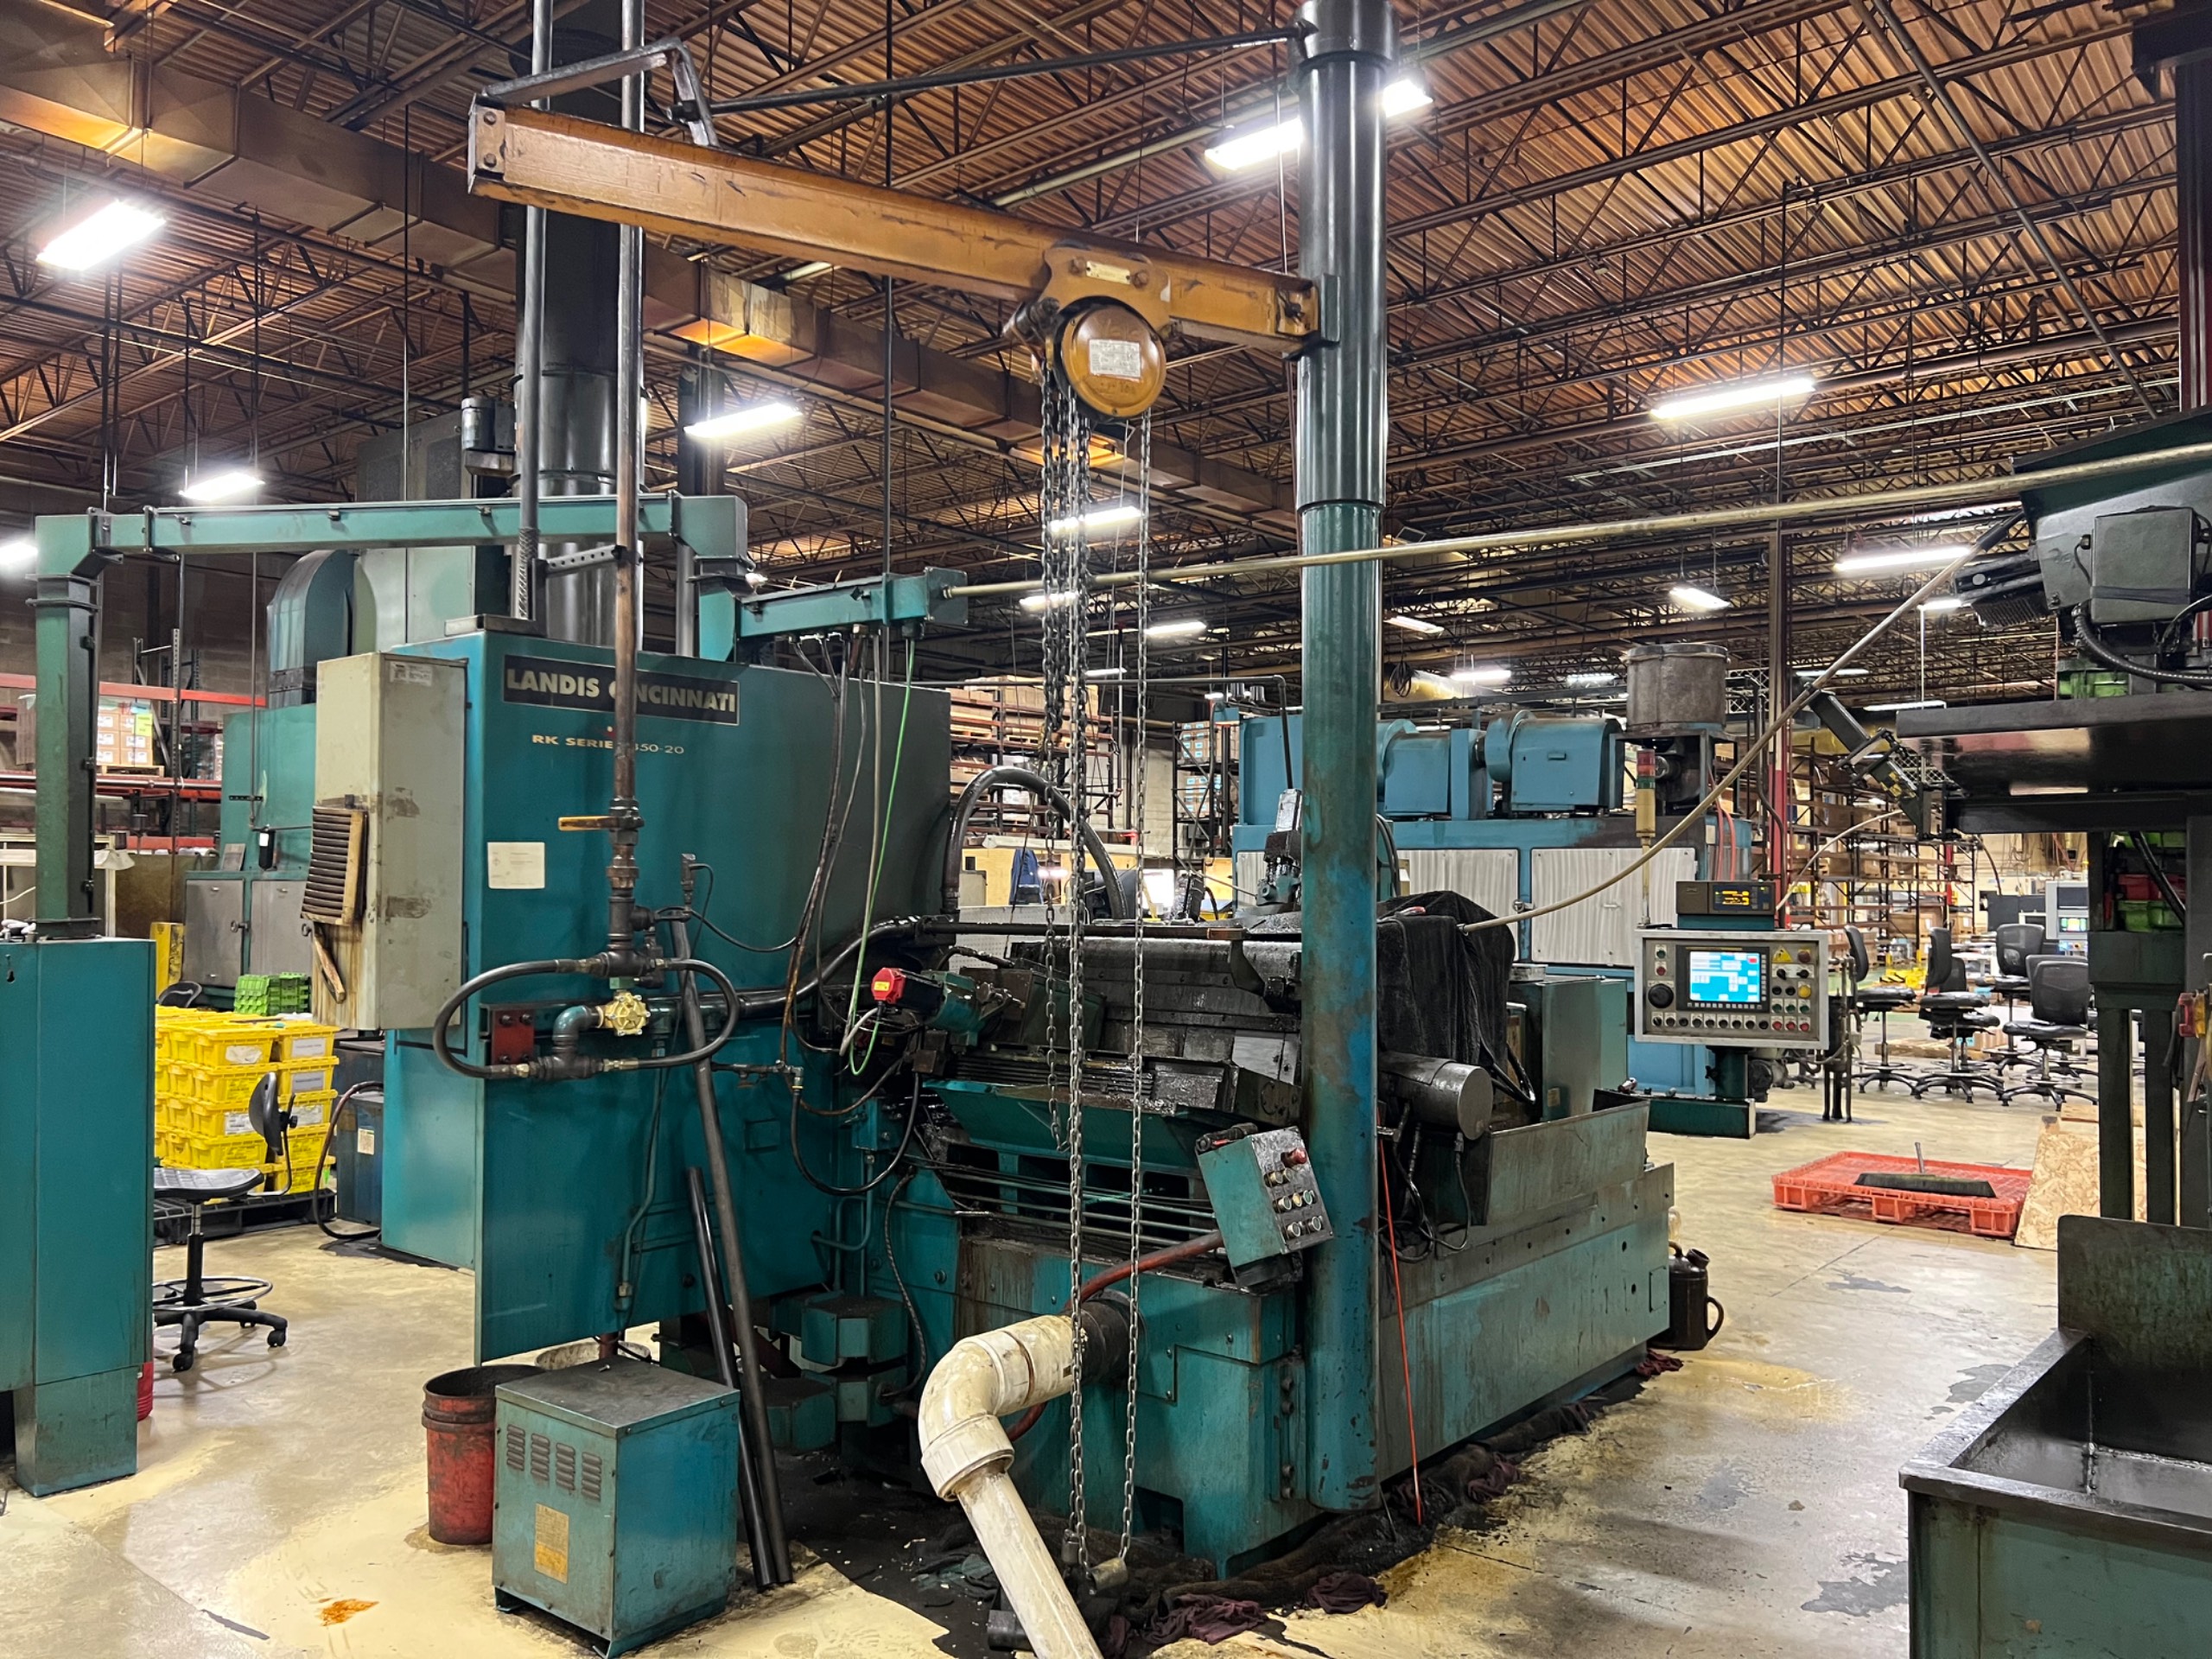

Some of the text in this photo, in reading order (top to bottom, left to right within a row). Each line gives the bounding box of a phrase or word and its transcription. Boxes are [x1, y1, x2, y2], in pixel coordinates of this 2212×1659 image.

[506, 668, 736, 713] LANDIS CNCINNATI
[531, 734, 559, 746] RK
[564, 737, 614, 749] SERIE
